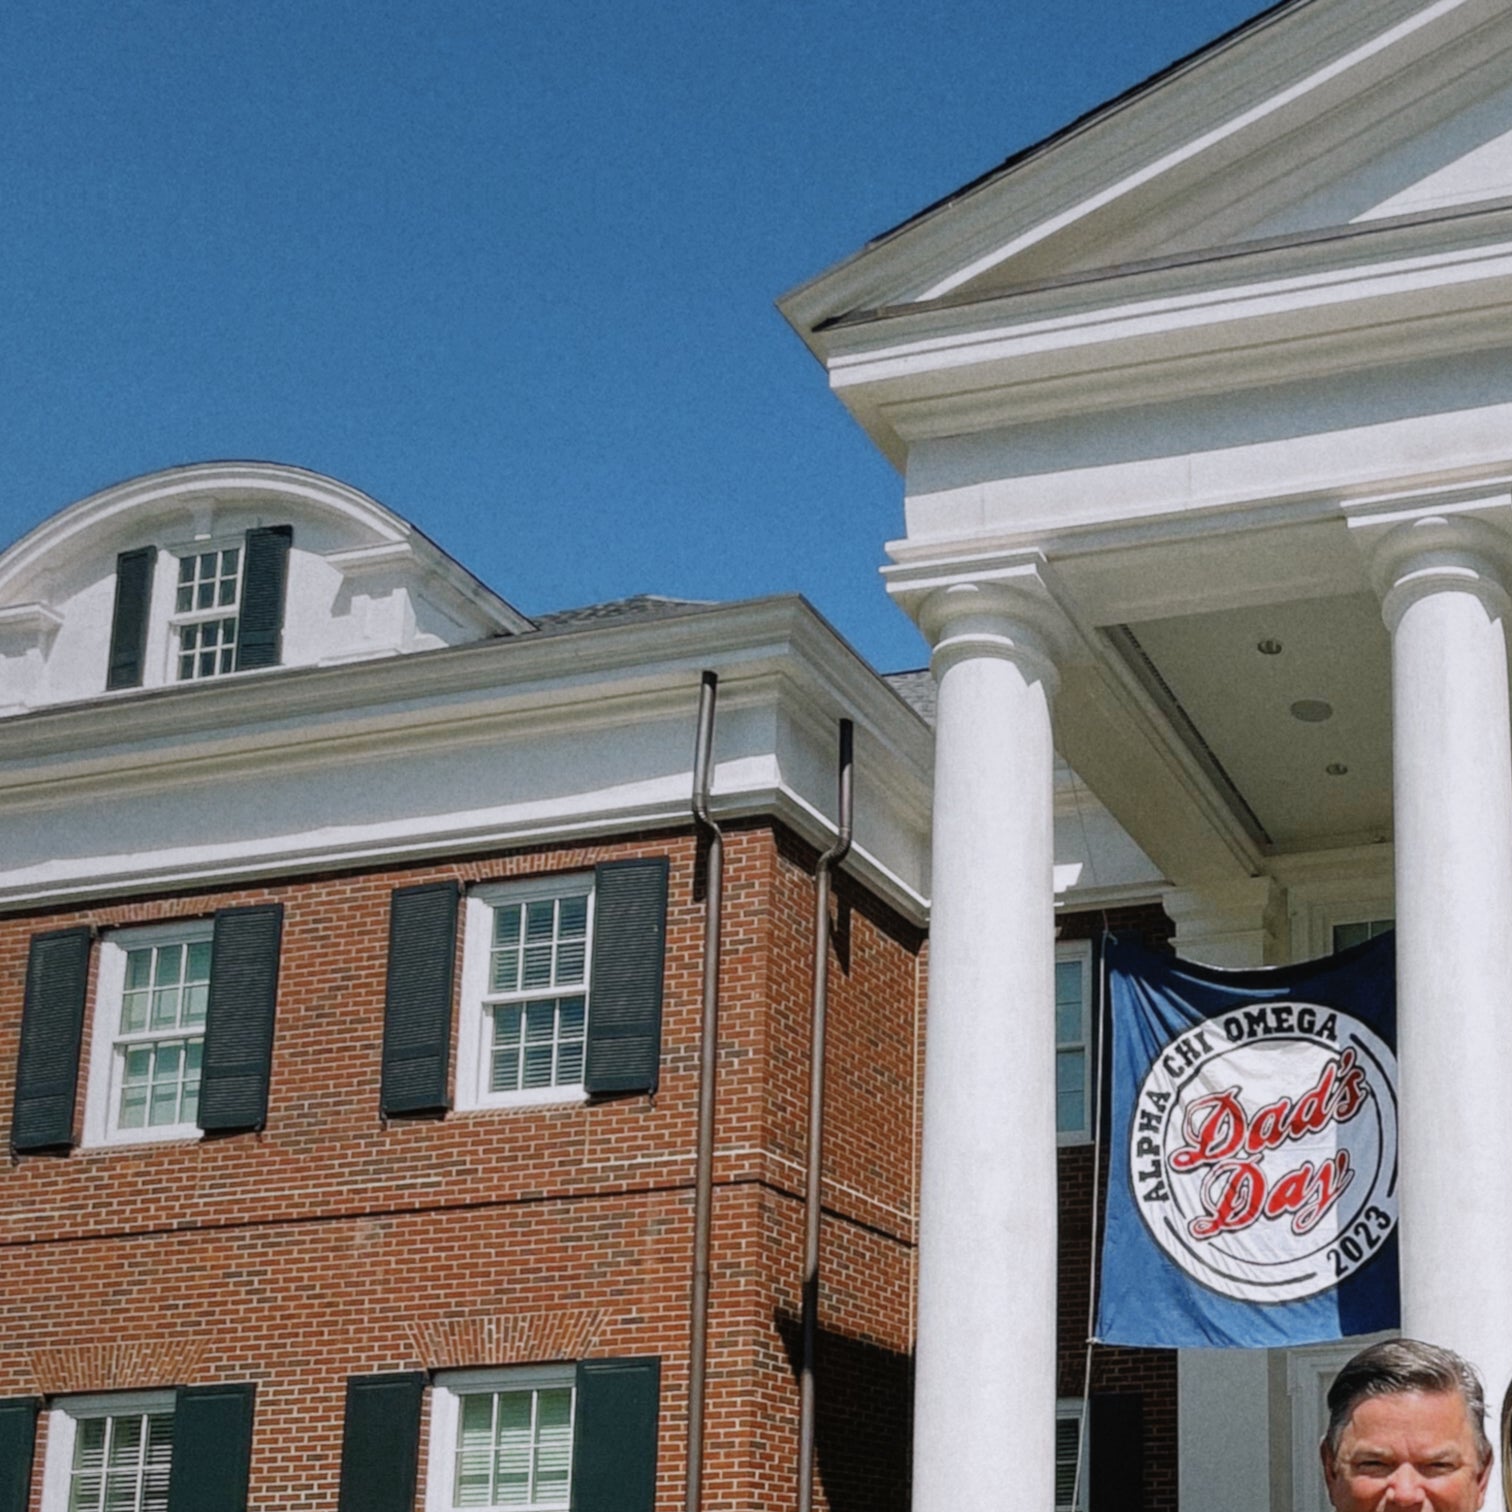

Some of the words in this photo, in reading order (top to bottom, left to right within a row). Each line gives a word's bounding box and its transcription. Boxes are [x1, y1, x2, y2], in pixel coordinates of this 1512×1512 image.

[1136, 1087, 1171, 1203] ALPHA
[1162, 1029, 1214, 1080] CHI
[1223, 1006, 1338, 1043] OMEGA
[1169, 1047, 1368, 1172] Dad's
[1189, 1150, 1354, 1240] Day
[1327, 1205, 1391, 1277] 2023
